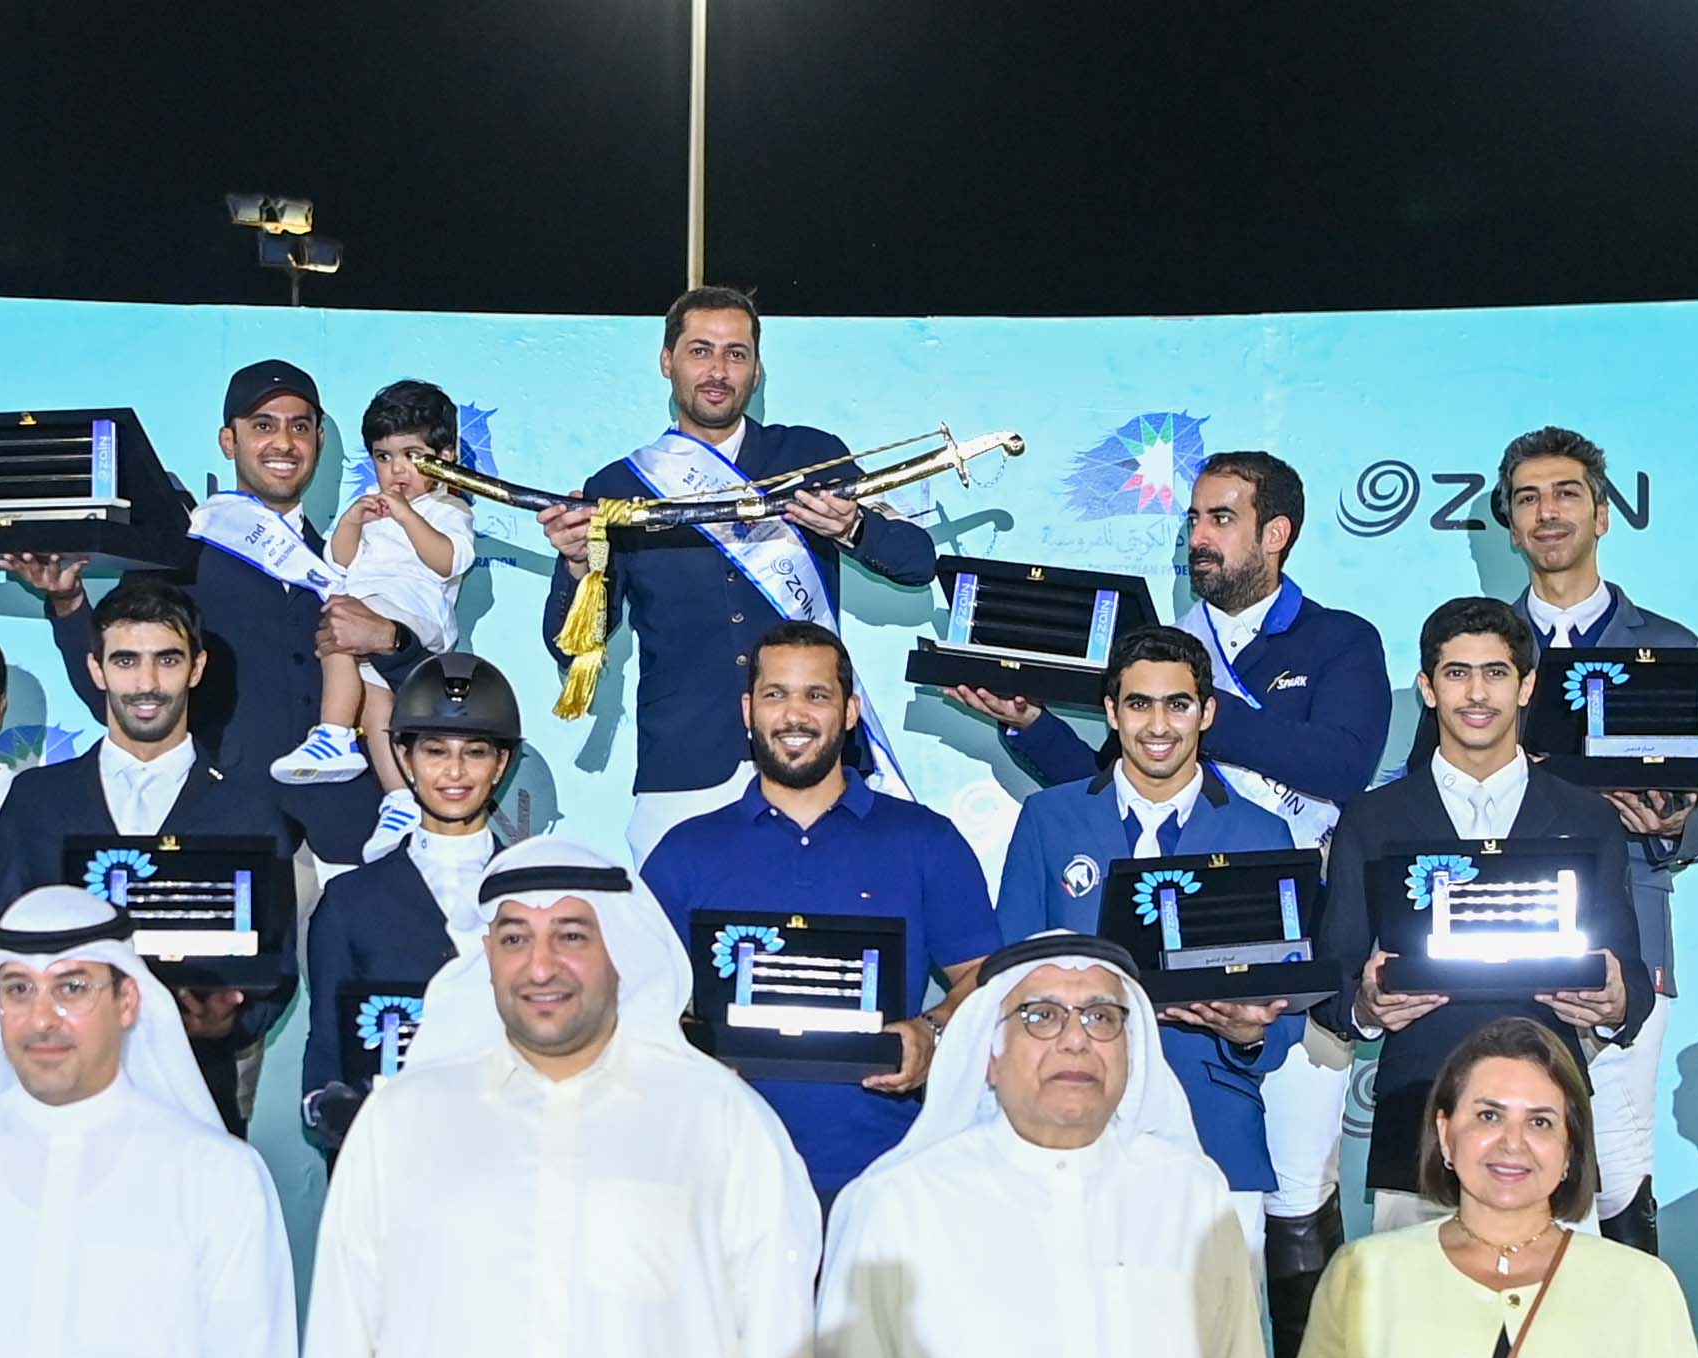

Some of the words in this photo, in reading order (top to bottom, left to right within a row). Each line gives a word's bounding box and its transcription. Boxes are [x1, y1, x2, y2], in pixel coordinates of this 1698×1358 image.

[682, 467, 699, 485] 1st
[1430, 472, 1650, 531] zN
[245, 523, 266, 545] 2nd
